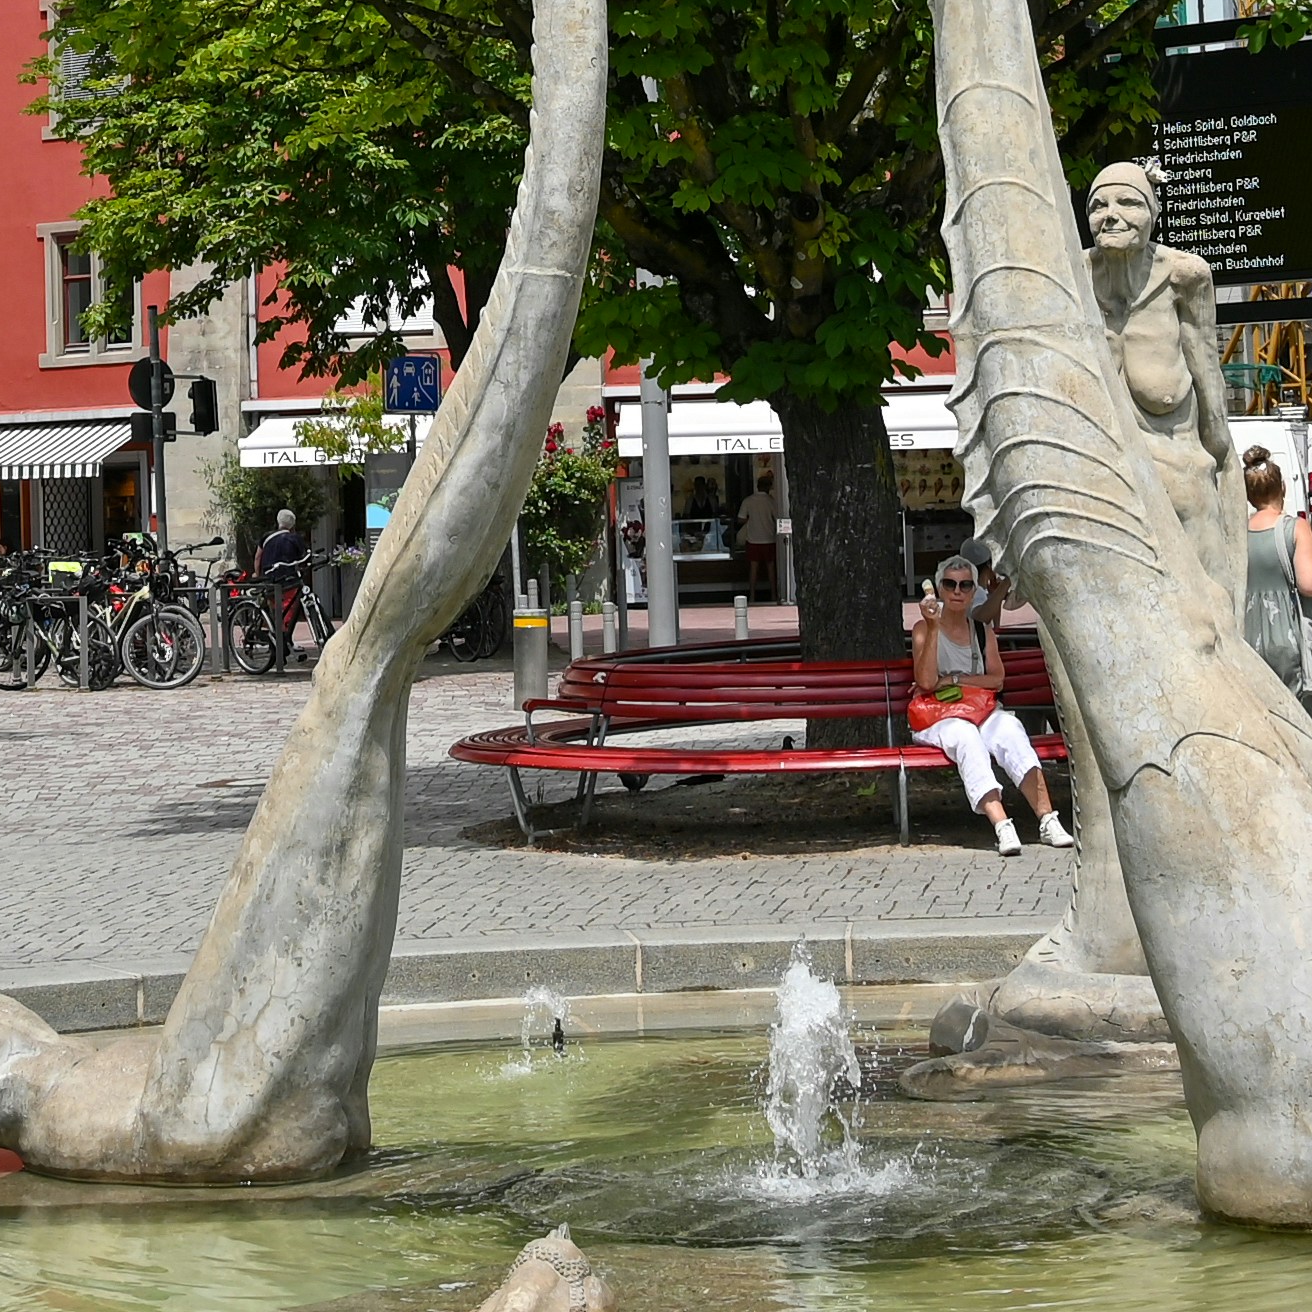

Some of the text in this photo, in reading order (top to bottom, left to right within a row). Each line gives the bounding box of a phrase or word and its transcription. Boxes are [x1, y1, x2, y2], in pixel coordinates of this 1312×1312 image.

[1151, 124, 1159, 136] 7
[1163, 122, 1192, 135] Helios
[1194, 118, 1228, 132] Spital,
[1230, 113, 1278, 128] Goldbach
[1152, 140, 1159, 151] 4
[1233, 130, 1258, 143] P&R
[1164, 148, 1243, 165] Friedrichshafen
[1236, 177, 1260, 190] P&R
[1166, 195, 1245, 212] Friedrichshafen
[1167, 214, 1196, 228] Helios
[1199, 211, 1233, 225] Spital,
[1235, 206, 1286, 222] Kurgebiet
[1157, 232, 1163, 244] 4
[1238, 224, 1263, 237] P&R
[1170, 242, 1247, 256] edrichshafen
[1225, 254, 1284, 270] Busbahnhof
[716, 437, 763, 451] ITAL.
[263, 451, 308, 464] ITAL.
